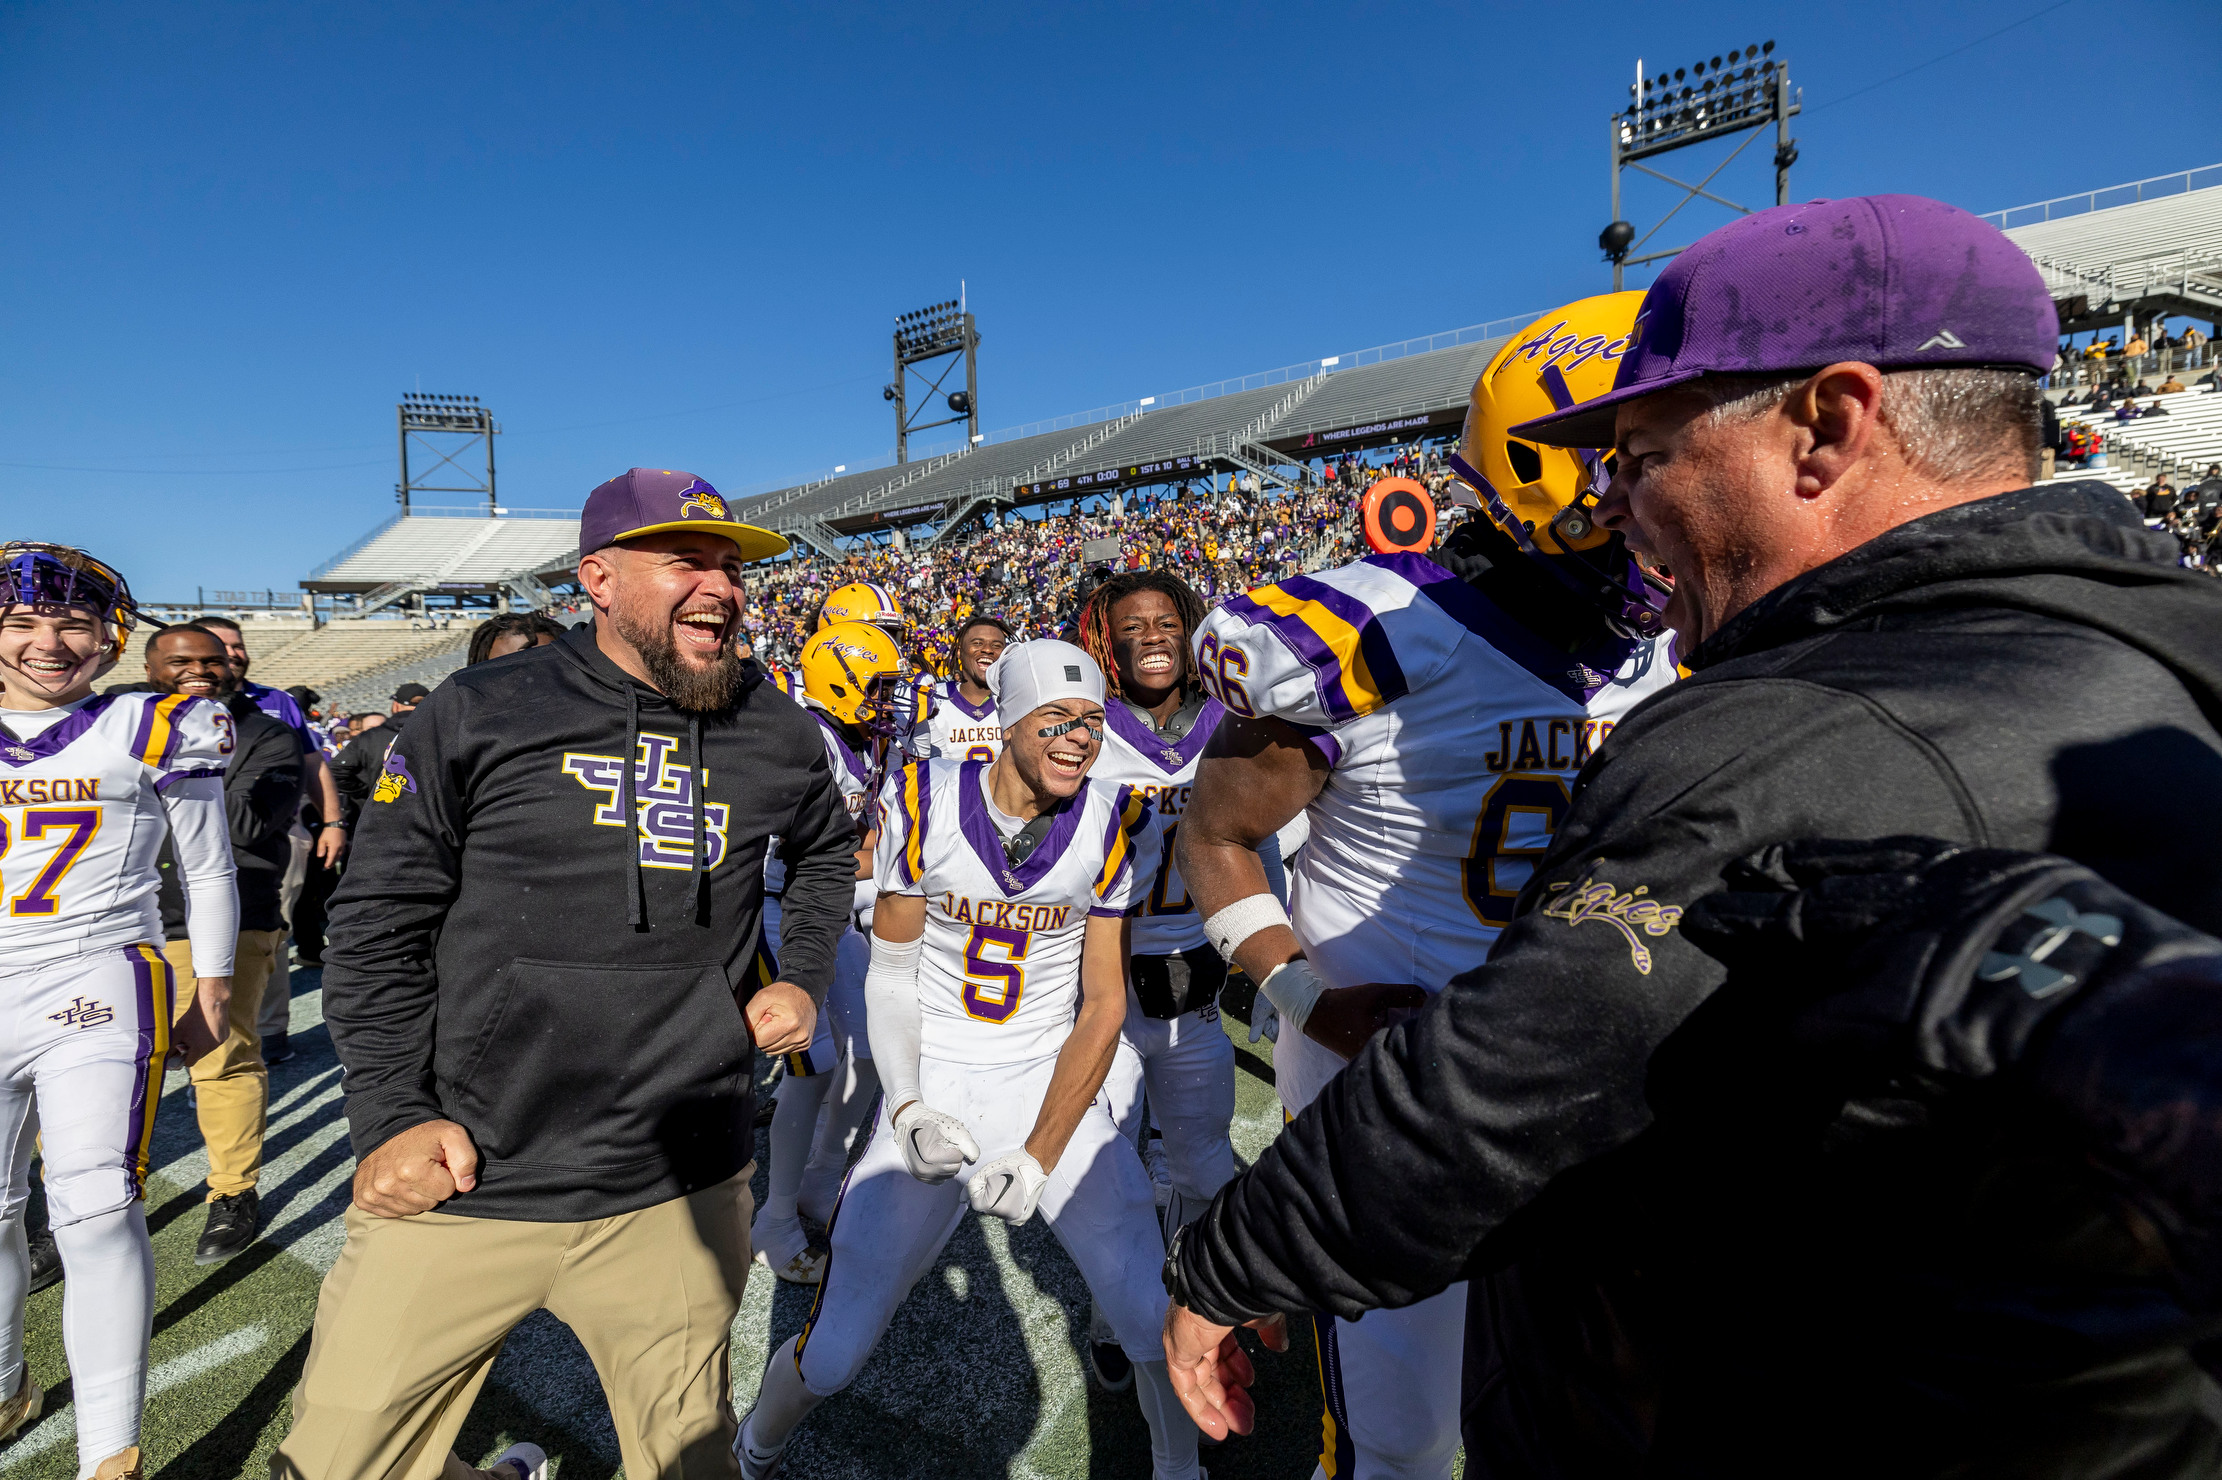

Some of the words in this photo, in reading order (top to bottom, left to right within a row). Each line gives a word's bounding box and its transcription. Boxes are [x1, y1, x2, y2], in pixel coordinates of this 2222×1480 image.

[1501, 320, 1632, 373] Aggi
[1301, 433, 1315, 448] A
[1322, 429, 1350, 440] WHERE
[1351, 422, 1386, 437] LEGENDS
[1387, 420, 1403, 430] ARE
[1404, 415, 1429, 427] MADE
[1033, 484, 1040, 493] 6
[1057, 478, 1069, 489] 69
[1077, 475, 1093, 485] 4TH
[1096, 469, 1119, 482] 0:00
[1130, 467, 1136, 476] 0
[1140, 464, 1154, 474] 1ST
[1154, 463, 1160, 471] &
[1162, 461, 1172, 470] 10
[1176, 456, 1191, 464] BALL
[883, 510, 899, 518] WHERE
[900, 506, 920, 515] LEGENDS
[817, 636, 879, 664] Aggies
[1199, 631, 1257, 720] 66
[212, 713, 235, 755] 3
[949, 726, 1003, 743] JACKSO
[1045, 722, 1070, 737] WIN
[0, 778, 101, 806] KSON
[0, 806, 103, 918] 7
[1461, 772, 1572, 928] 6
[940, 891, 1072, 932] JACKSON
[960, 924, 1033, 1026] 5
